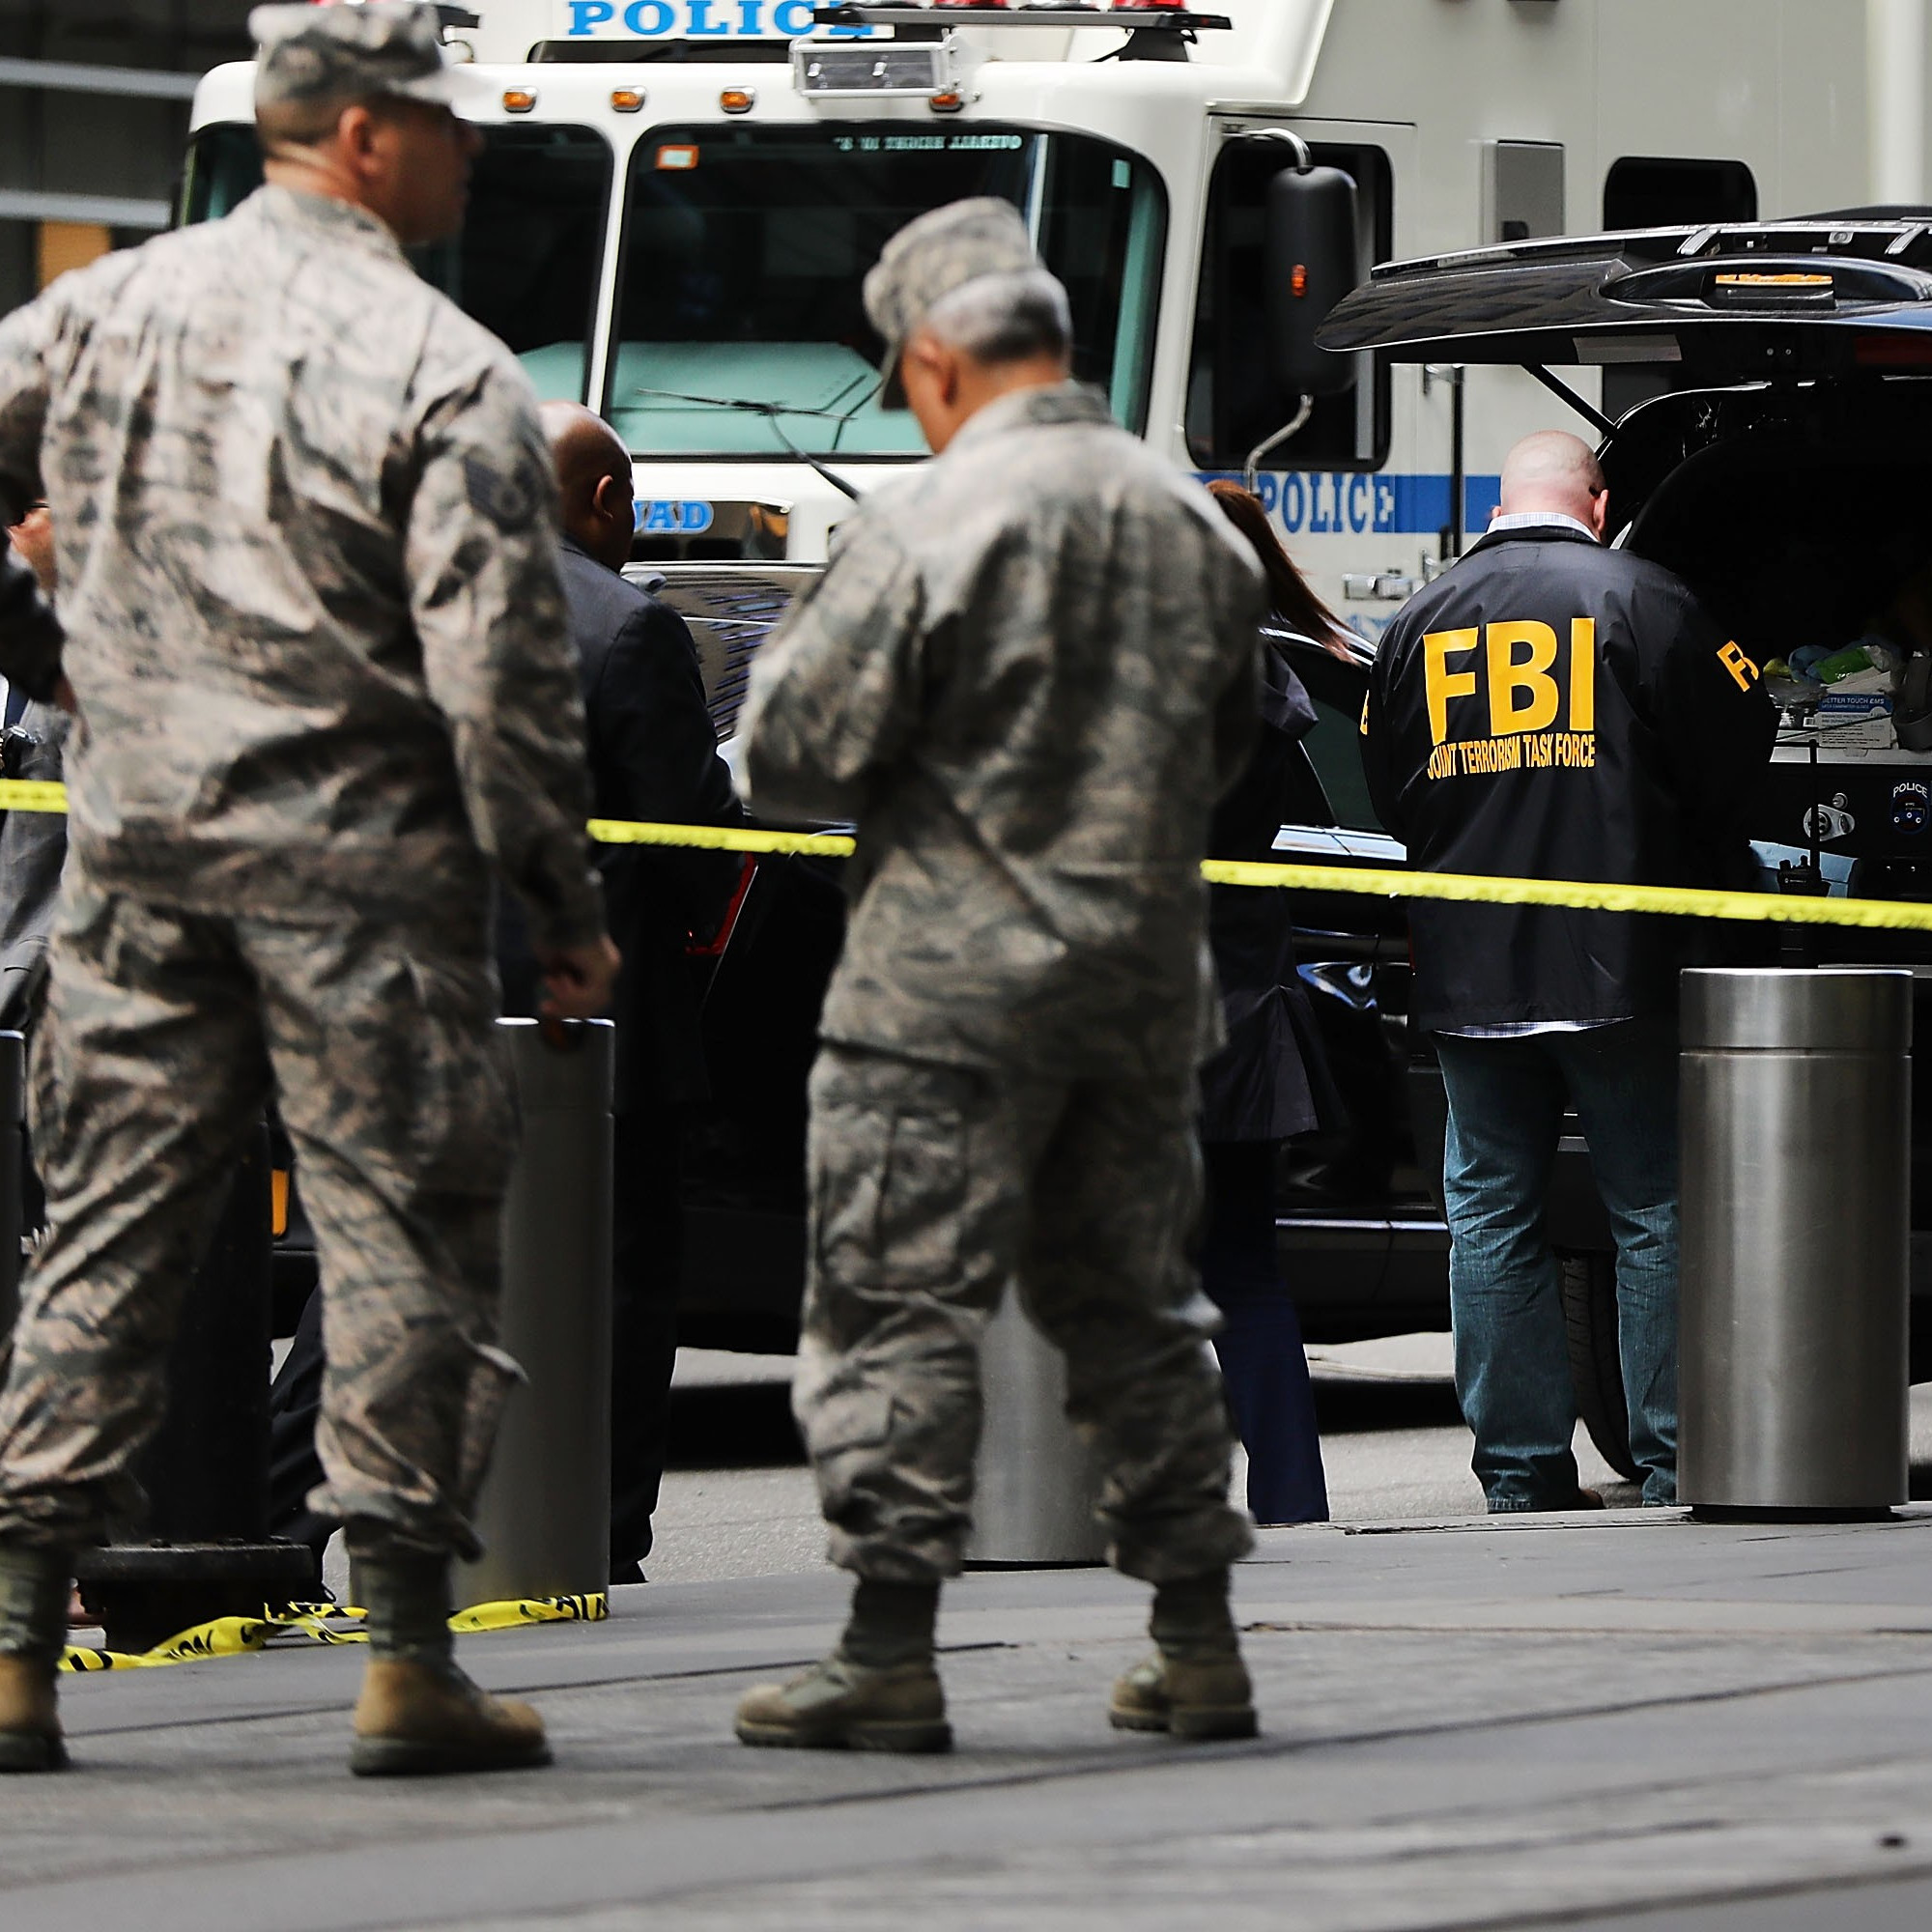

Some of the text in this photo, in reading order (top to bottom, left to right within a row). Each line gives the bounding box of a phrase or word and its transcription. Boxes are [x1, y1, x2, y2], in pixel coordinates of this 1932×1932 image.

[1258, 471, 1394, 533] POLICE
[1423, 617, 1596, 746] FBI
[1427, 733, 1596, 780] JOINT TERRORISM TASK FORCE
[1893, 782, 1928, 799] POLICE
